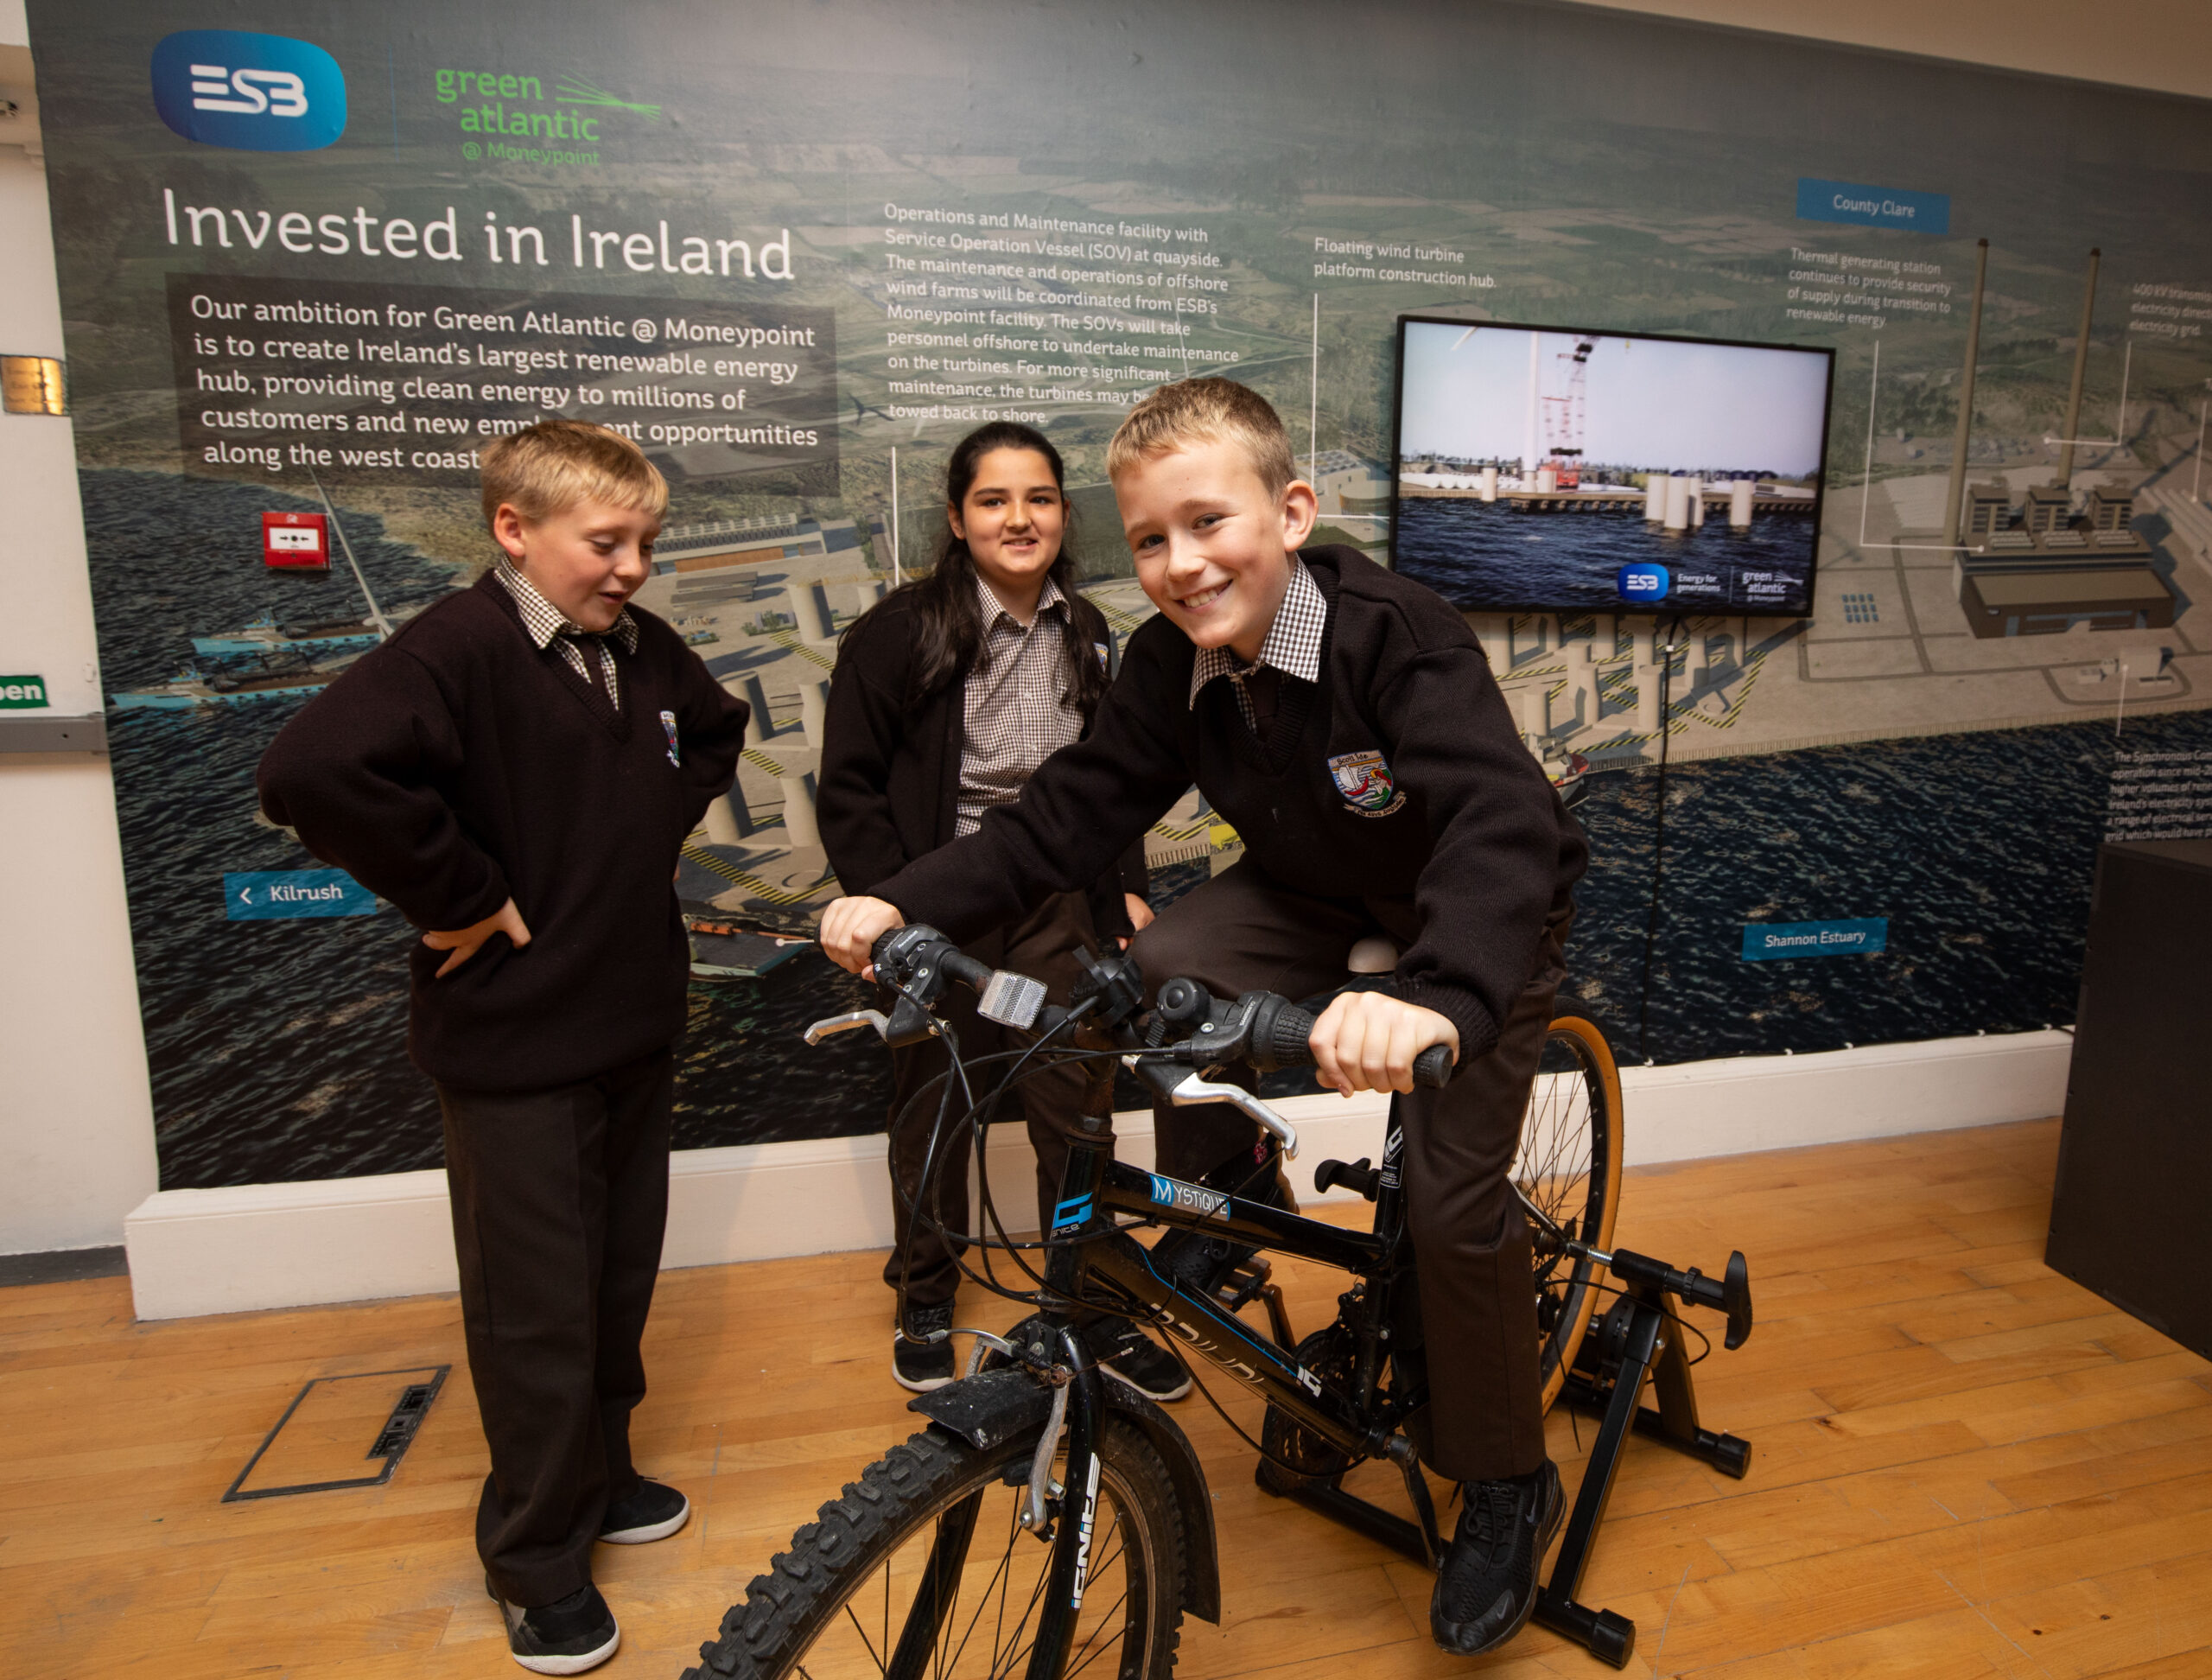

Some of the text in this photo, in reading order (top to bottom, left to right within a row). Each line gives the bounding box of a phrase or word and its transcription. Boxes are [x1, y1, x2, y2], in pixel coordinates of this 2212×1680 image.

[190, 64, 309, 117] ESB
[435, 67, 543, 104] green
[460, 104, 600, 141] atlantic
[462, 141, 600, 167] @ Moneypoint
[1834, 194, 1915, 217] County Clare
[165, 189, 795, 279] Invested in Ireland
[885, 203, 1207, 242] Operations and Maintenance facility with
[885, 228, 1223, 268] Service Operation Vessel (SOV) at quayside.
[1315, 237, 1464, 263] Floating wind turbine
[1791, 247, 1941, 275] Thermal generating station
[886, 254, 1228, 290] The maintenance and operations of offshore
[1314, 262, 1496, 288] platform construction hub.
[1789, 270, 1951, 297] continues to provide security
[887, 281, 1217, 314] wind farms will be coordinated from ESB's
[1788, 287, 1951, 313] of supply during transition to
[192, 296, 815, 348] Our ambition for Green Atlantic @ Moneypoint
[888, 304, 1190, 335] Moneypoint facility. The SOVs will take
[1787, 308, 1886, 328] renewable energy.
[195, 333, 798, 385] is to create Ireland's largest renewable energy
[887, 333, 1238, 362] personnel offshore to undertake maintenance
[888, 355, 1170, 383] on the turbines. For more significant
[198, 369, 746, 410] hub, providing clean energy to millions of
[889, 380, 995, 398] maintenance,
[1000, 384, 1024, 398] the
[1029, 386, 1092, 401] turbines
[1097, 391, 1128, 406] may
[889, 404, 1048, 423] towed back to shore.
[202, 409, 348, 430] customers
[357, 411, 406, 432] and
[414, 417, 469, 434] new
[650, 424, 817, 446] opportunities
[205, 442, 480, 471] along the west coast
[1627, 575, 1658, 590] ESB
[1677, 583, 1720, 594] generations
[1678, 574, 1704, 584] Energy
[1742, 572, 1772, 584] green
[1748, 582, 1786, 594] atlantic
[0, 684, 43, 700] en
[271, 884, 342, 900] Kilrush
[1765, 932, 1866, 947] Shannon Estuary
